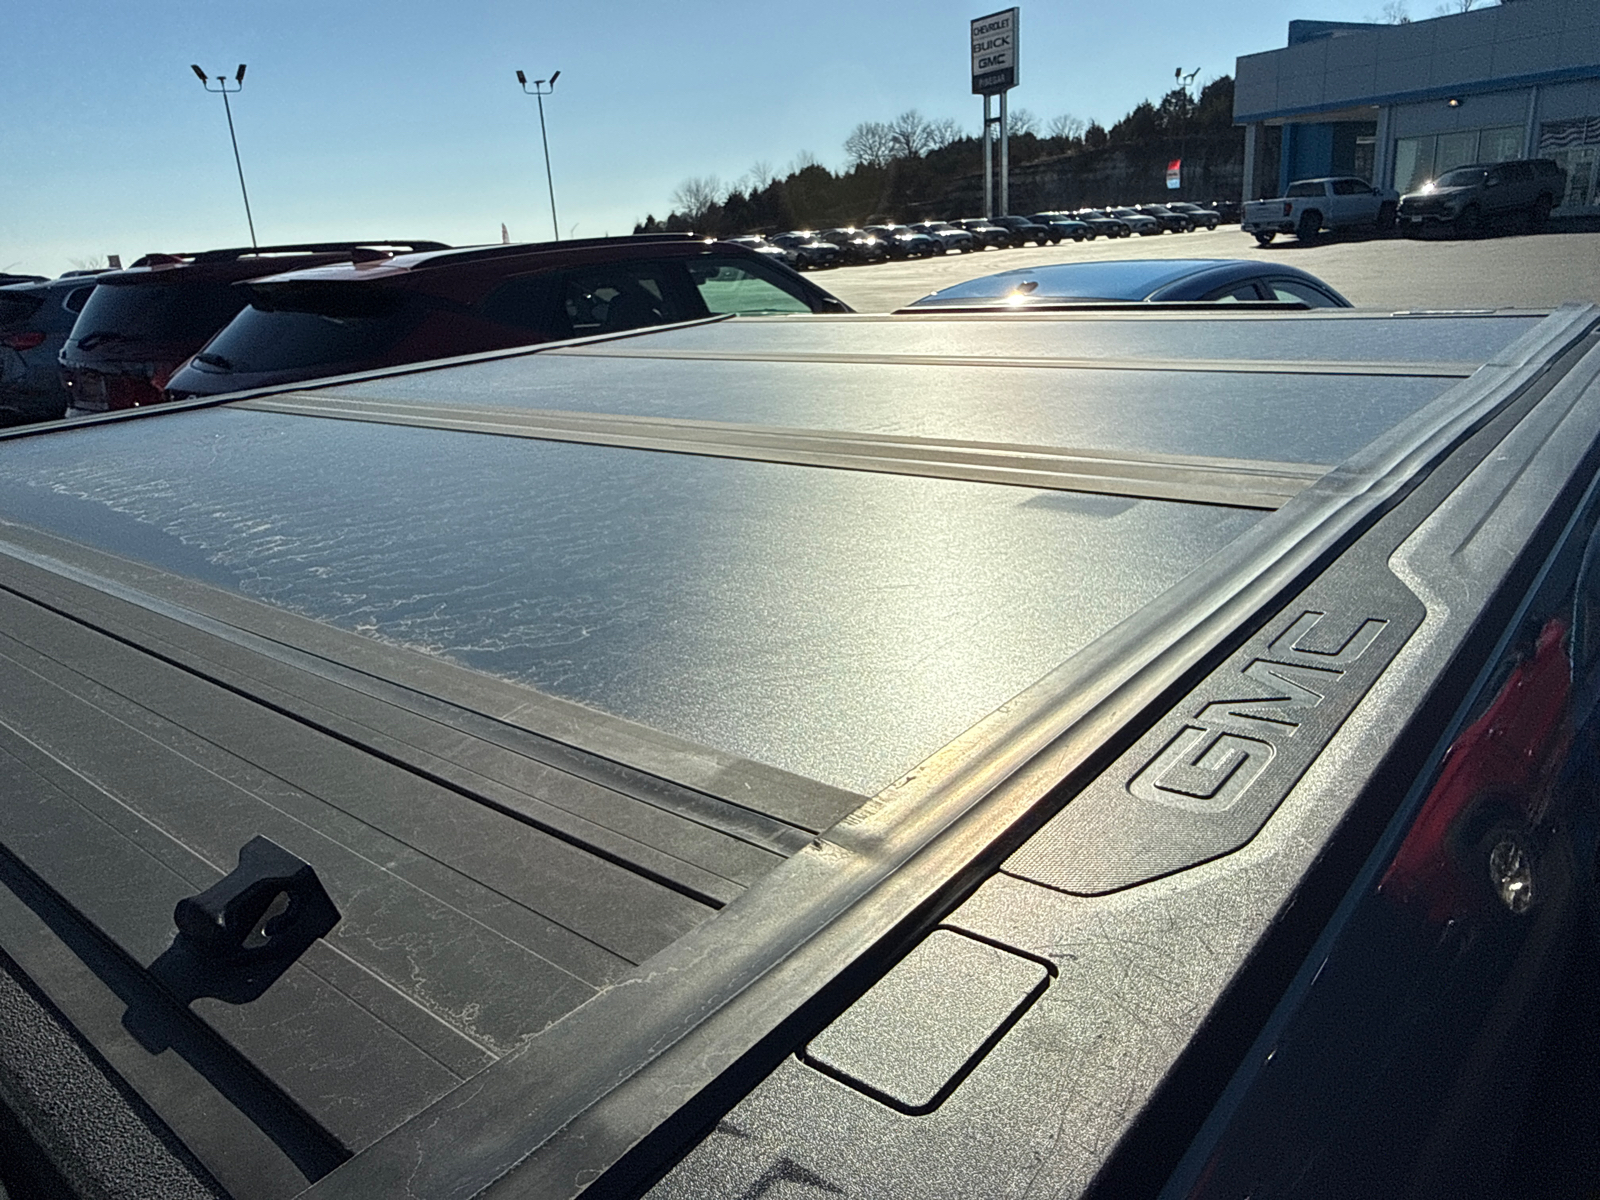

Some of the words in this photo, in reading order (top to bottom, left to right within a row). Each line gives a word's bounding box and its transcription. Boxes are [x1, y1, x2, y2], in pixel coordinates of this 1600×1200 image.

[973, 18, 1010, 36] CHEVROLET
[973, 35, 1010, 53] BUICK
[978, 53, 1006, 69] GMC
[1126, 609, 1391, 814] GMC
